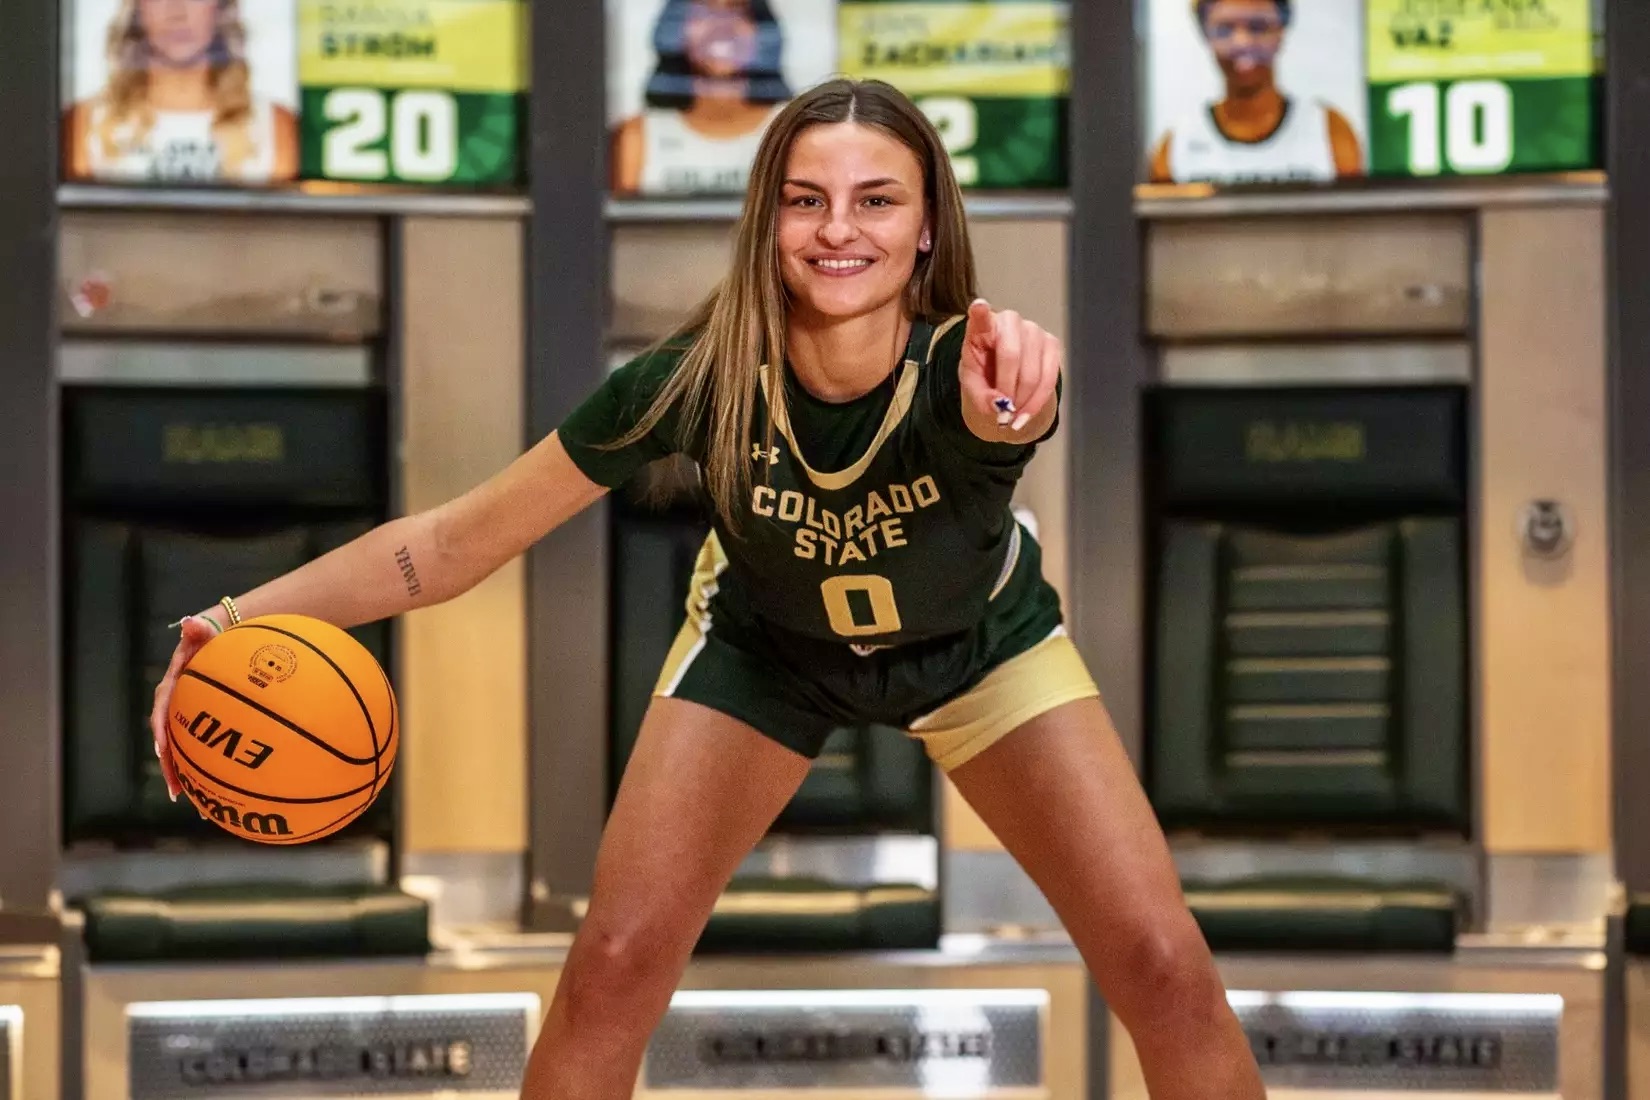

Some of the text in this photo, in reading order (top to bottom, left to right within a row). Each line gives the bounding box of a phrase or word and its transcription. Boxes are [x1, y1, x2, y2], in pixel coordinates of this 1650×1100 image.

[321, 87, 460, 180] 20
[1386, 80, 1514, 175] 10
[751, 474, 941, 540] COLORADO
[394, 544, 422, 598] YHWH
[793, 517, 909, 566] STATE
[820, 573, 902, 637] 0
[174, 710, 274, 770] EVO NXT
